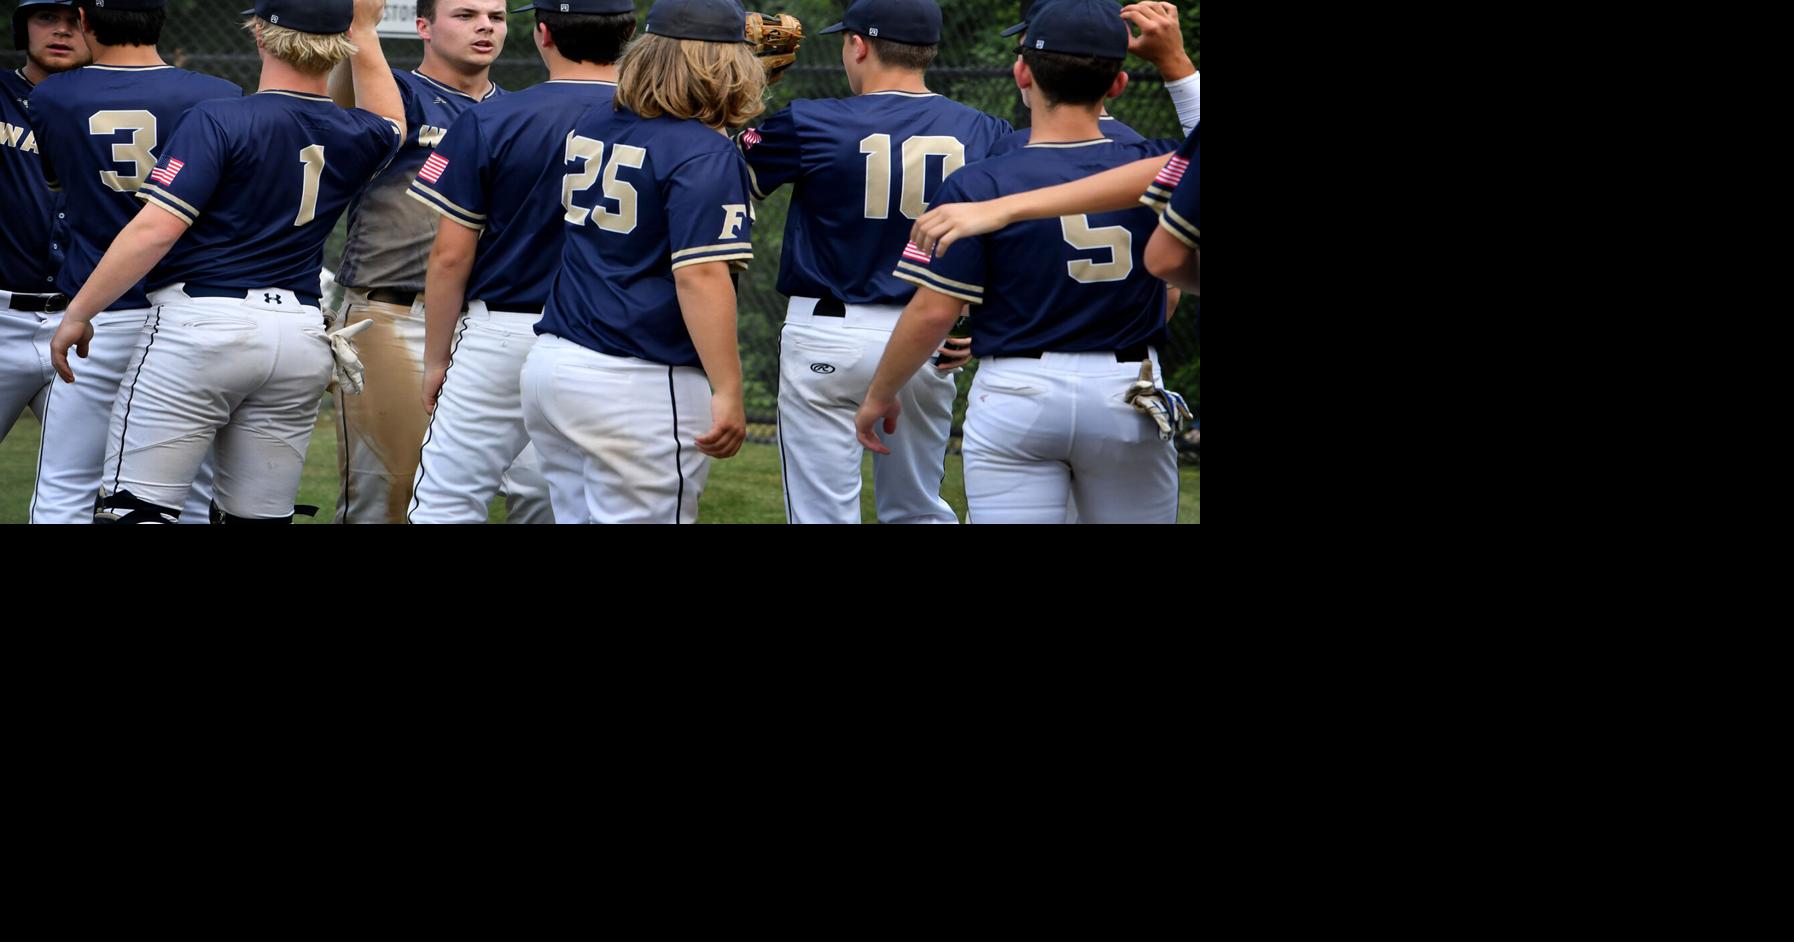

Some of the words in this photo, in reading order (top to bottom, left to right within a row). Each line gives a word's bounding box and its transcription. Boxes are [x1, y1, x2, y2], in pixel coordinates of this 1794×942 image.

[89, 110, 157, 192] 3
[294, 144, 325, 227] 1
[562, 129, 646, 234] 25
[860, 133, 966, 219] 10
[718, 204, 747, 240] F
[1060, 213, 1133, 283] 5
